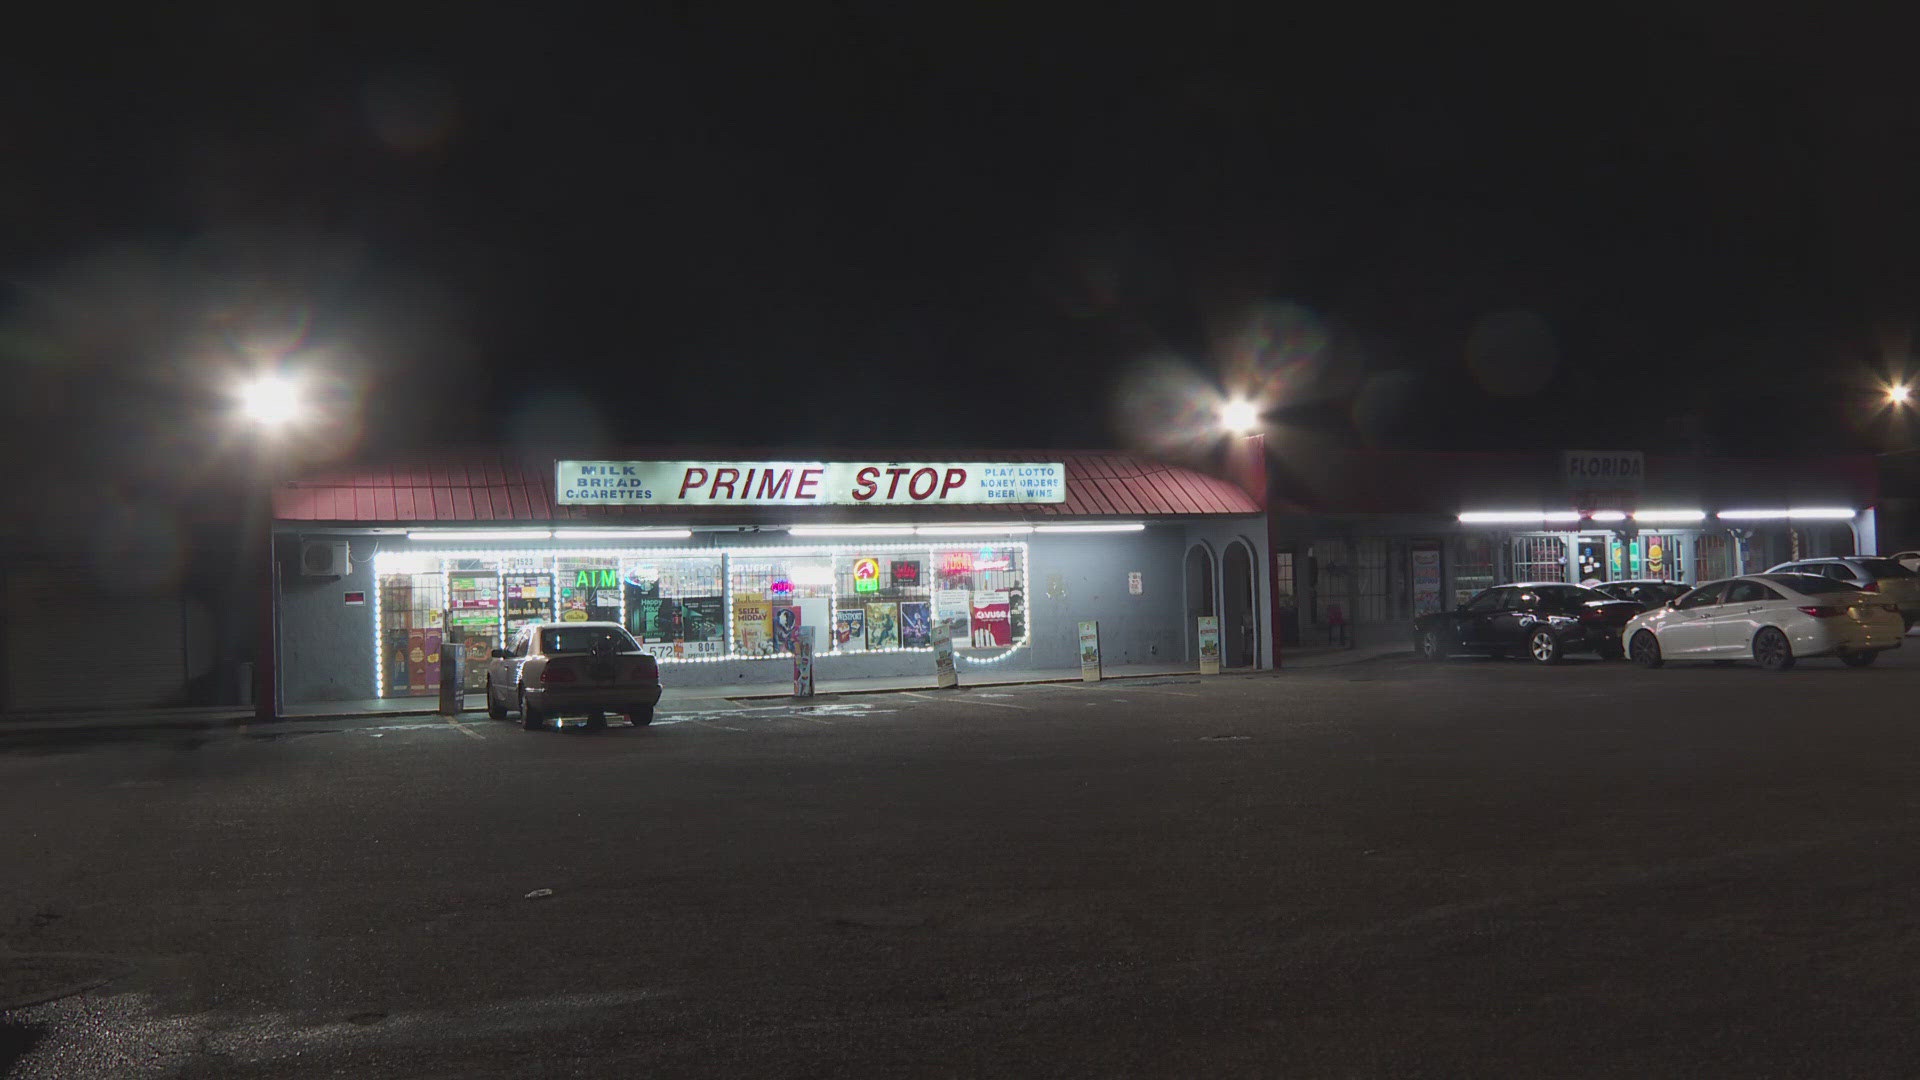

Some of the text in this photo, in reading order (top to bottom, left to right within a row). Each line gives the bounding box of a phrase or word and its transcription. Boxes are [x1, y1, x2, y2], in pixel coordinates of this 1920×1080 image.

[581, 466, 636, 476] MILK
[1570, 457, 1641, 477] FLORIDA
[985, 468, 1055, 477] PLAY LOTTO
[577, 478, 642, 488] BREAD
[678, 467, 967, 500] PRIME STOP
[981, 479, 1058, 488] MONEY ORDERS
[566, 489, 652, 499] CIGARETTES
[988, 489, 1053, 498] BEER WINE
[516, 558, 534, 567] 1523
[576, 569, 617, 589] ATM
[641, 599, 663, 609] Happy
[738, 607, 760, 615] SEIZE
[738, 614, 767, 622] MIDDAY
[649, 646, 673, 659] 572
[698, 642, 715, 653] 804
